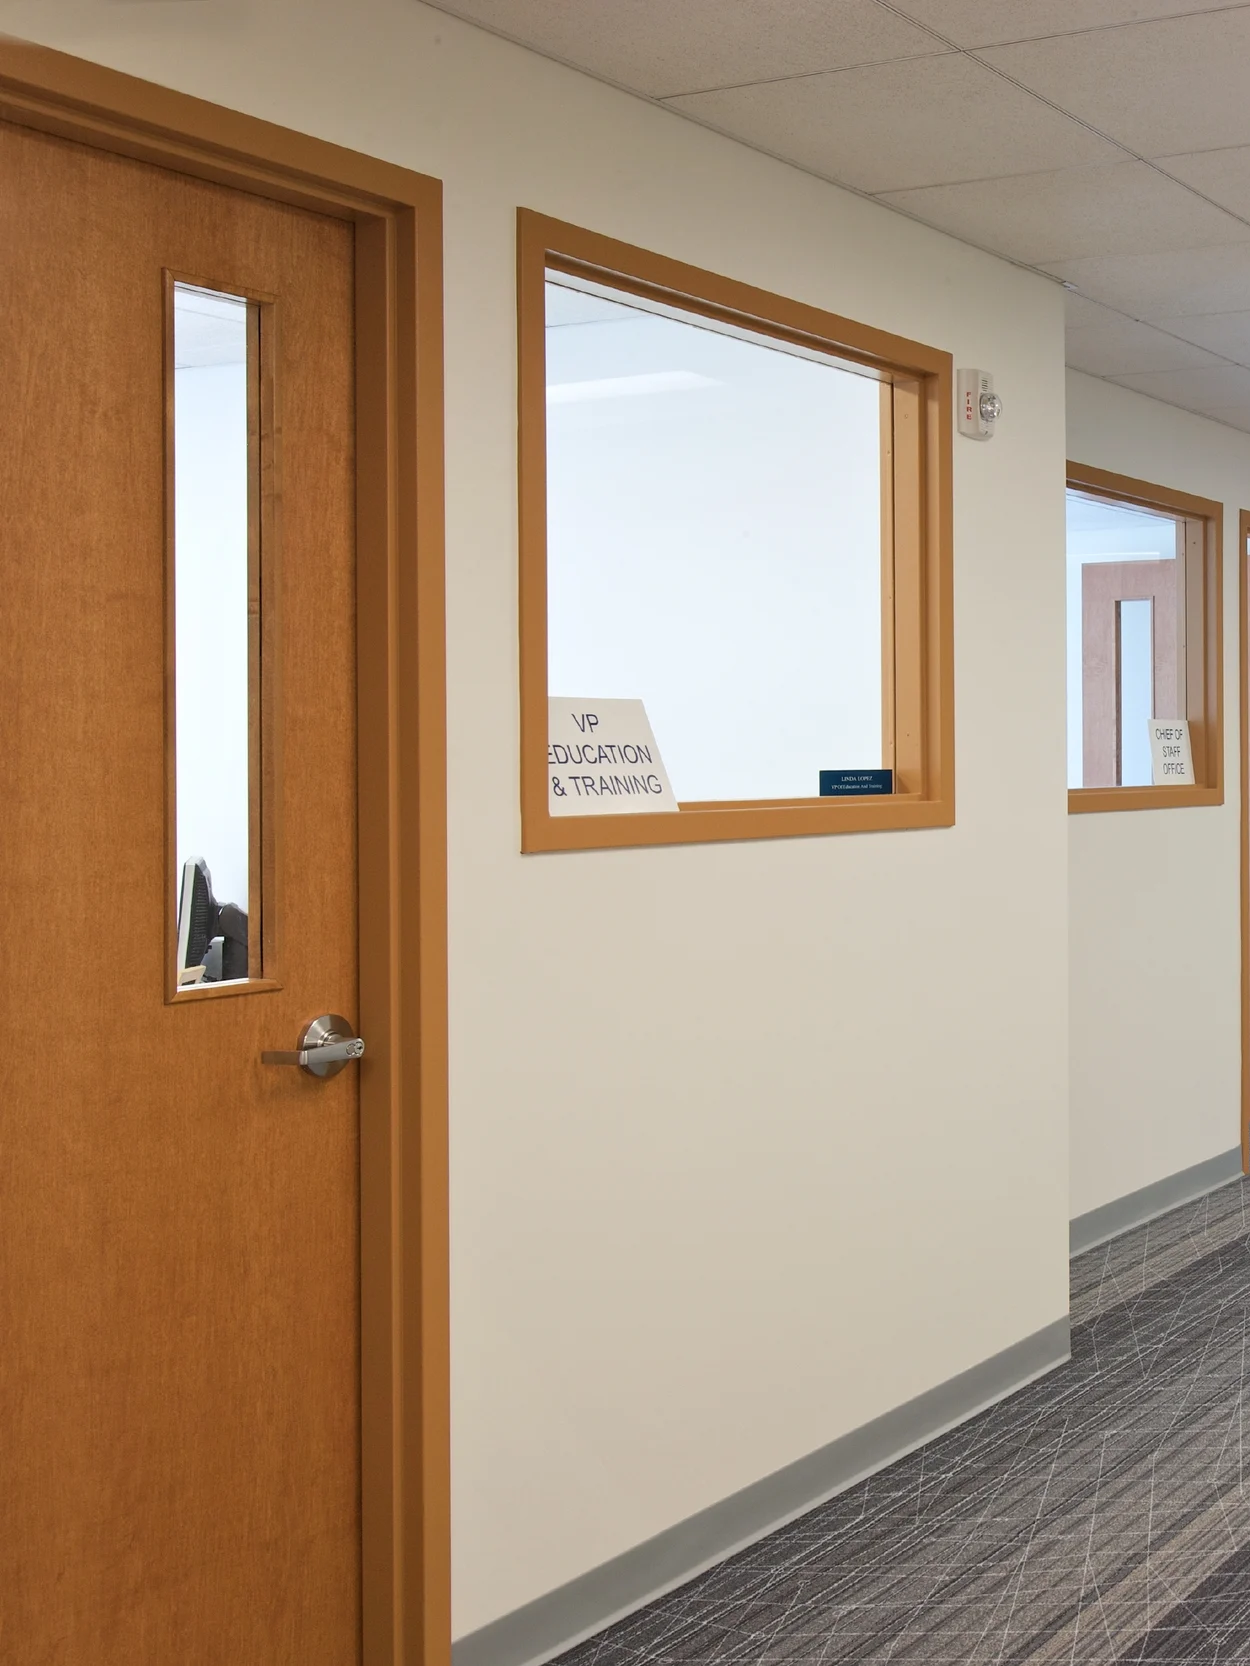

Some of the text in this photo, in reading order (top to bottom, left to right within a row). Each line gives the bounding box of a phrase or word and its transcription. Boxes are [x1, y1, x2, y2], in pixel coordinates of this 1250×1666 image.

[571, 713, 599, 733] VP
[1155, 728, 1183, 740] CHIEF OF
[548, 744, 653, 765] EDUCATION
[1162, 745, 1181, 758] STAFF
[1163, 762, 1185, 775] OFFICE
[551, 774, 663, 797] & TRAINING
